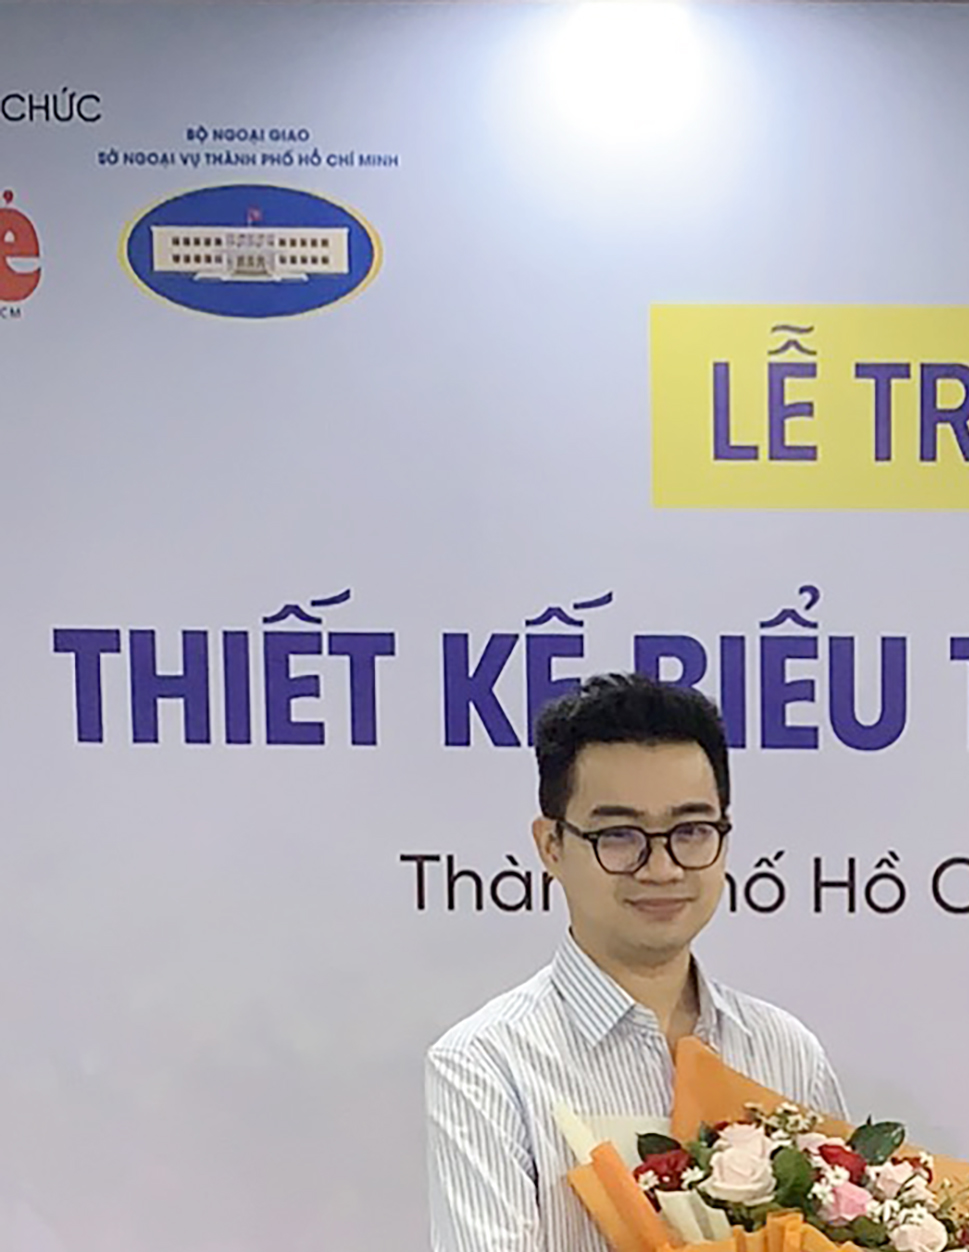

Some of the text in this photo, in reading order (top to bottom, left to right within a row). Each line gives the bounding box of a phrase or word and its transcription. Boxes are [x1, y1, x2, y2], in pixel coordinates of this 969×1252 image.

[1, 86, 101, 123] CHỨC
[123, 150, 175, 168] NGOẠI
[181, 151, 200, 168] VỤ
[204, 149, 256, 166] THÀNH
[261, 149, 293, 167] PHỐ
[326, 150, 355, 167] CHÍ
[358, 152, 399, 167] MINH
[186, 126, 310, 145] BỘ NGOẠI GIAO
[711, 324, 818, 461] LỄ
[53, 588, 396, 746] THIẾT
[813, 850, 906, 914] Hồ
